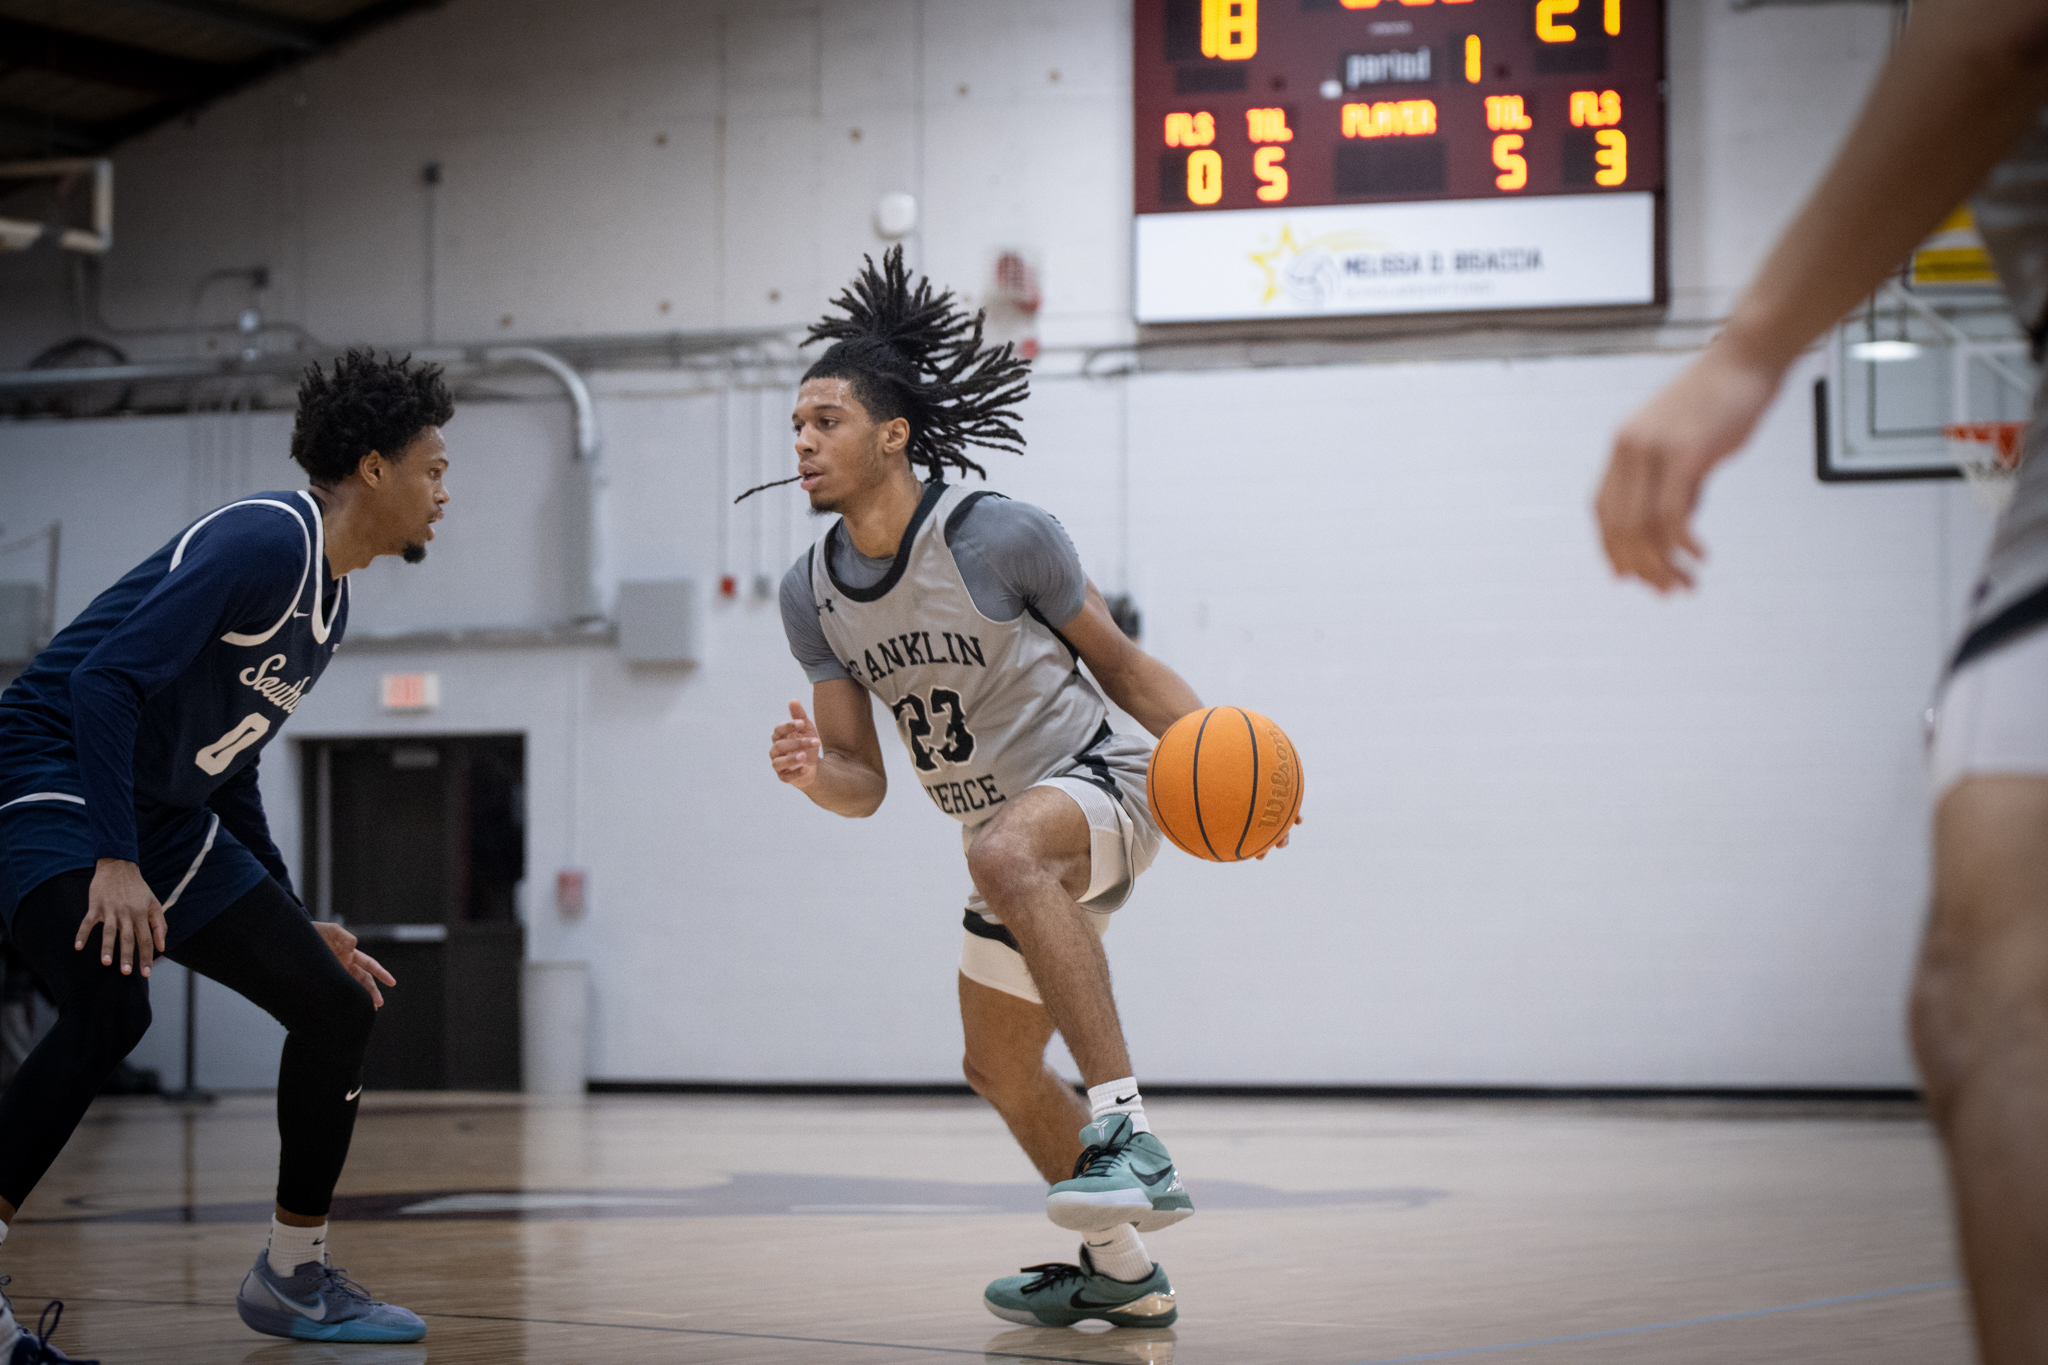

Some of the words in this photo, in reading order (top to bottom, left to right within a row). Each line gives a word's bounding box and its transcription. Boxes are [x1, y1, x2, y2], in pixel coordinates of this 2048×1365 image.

[1201, 0, 1258, 60] 18
[1346, 46, 1431, 88] period
[1465, 34, 1481, 83] 1
[1187, 149, 1222, 205] 0
[1254, 146, 1288, 201] 5
[1493, 134, 1527, 190] 5
[1595, 129, 1627, 186] 3
[195, 712, 271, 776] 0
[891, 686, 977, 775] 23
[922, 773, 1006, 814] IERCE
[1257, 724, 1293, 830] Wilson
